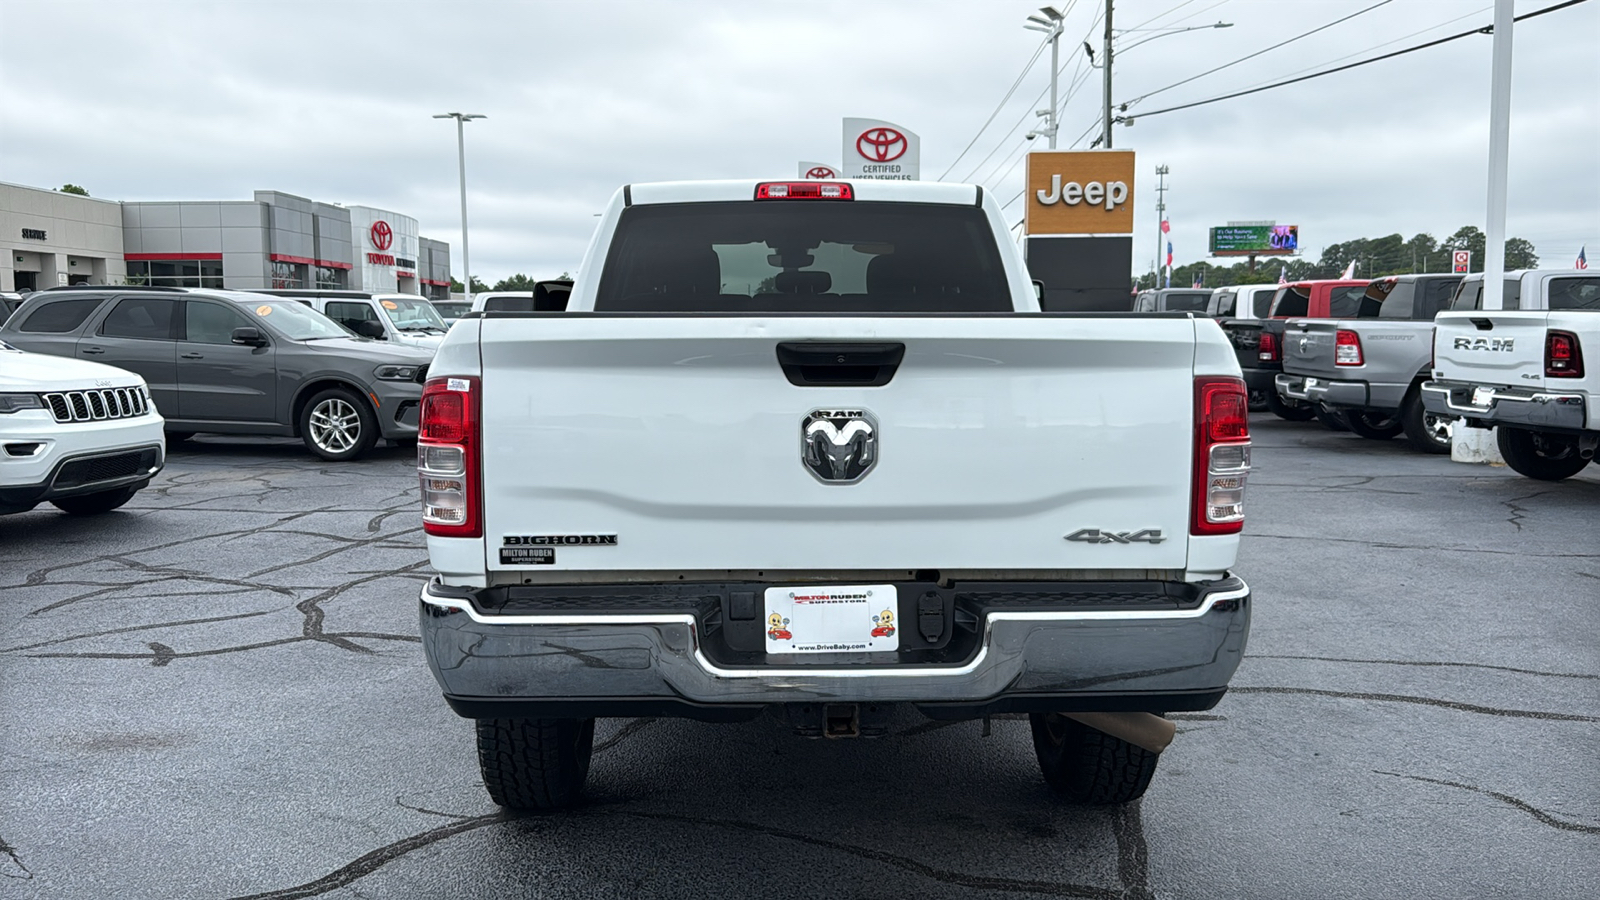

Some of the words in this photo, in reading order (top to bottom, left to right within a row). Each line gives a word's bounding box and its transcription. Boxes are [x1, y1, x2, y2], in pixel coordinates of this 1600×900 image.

[863, 165, 901, 173] CERTIFIED
[1037, 174, 1128, 211] Jeep
[22, 228, 47, 241] SERVICE
[368, 253, 395, 266] TOYOTA
[1454, 337, 1514, 352] RAM
[817, 410, 862, 418] RAM
[503, 535, 617, 546] BIGHORN
[1063, 529, 1167, 544] 4x4
[502, 549, 527, 557] MILTON
[529, 549, 552, 557] RUBEN
